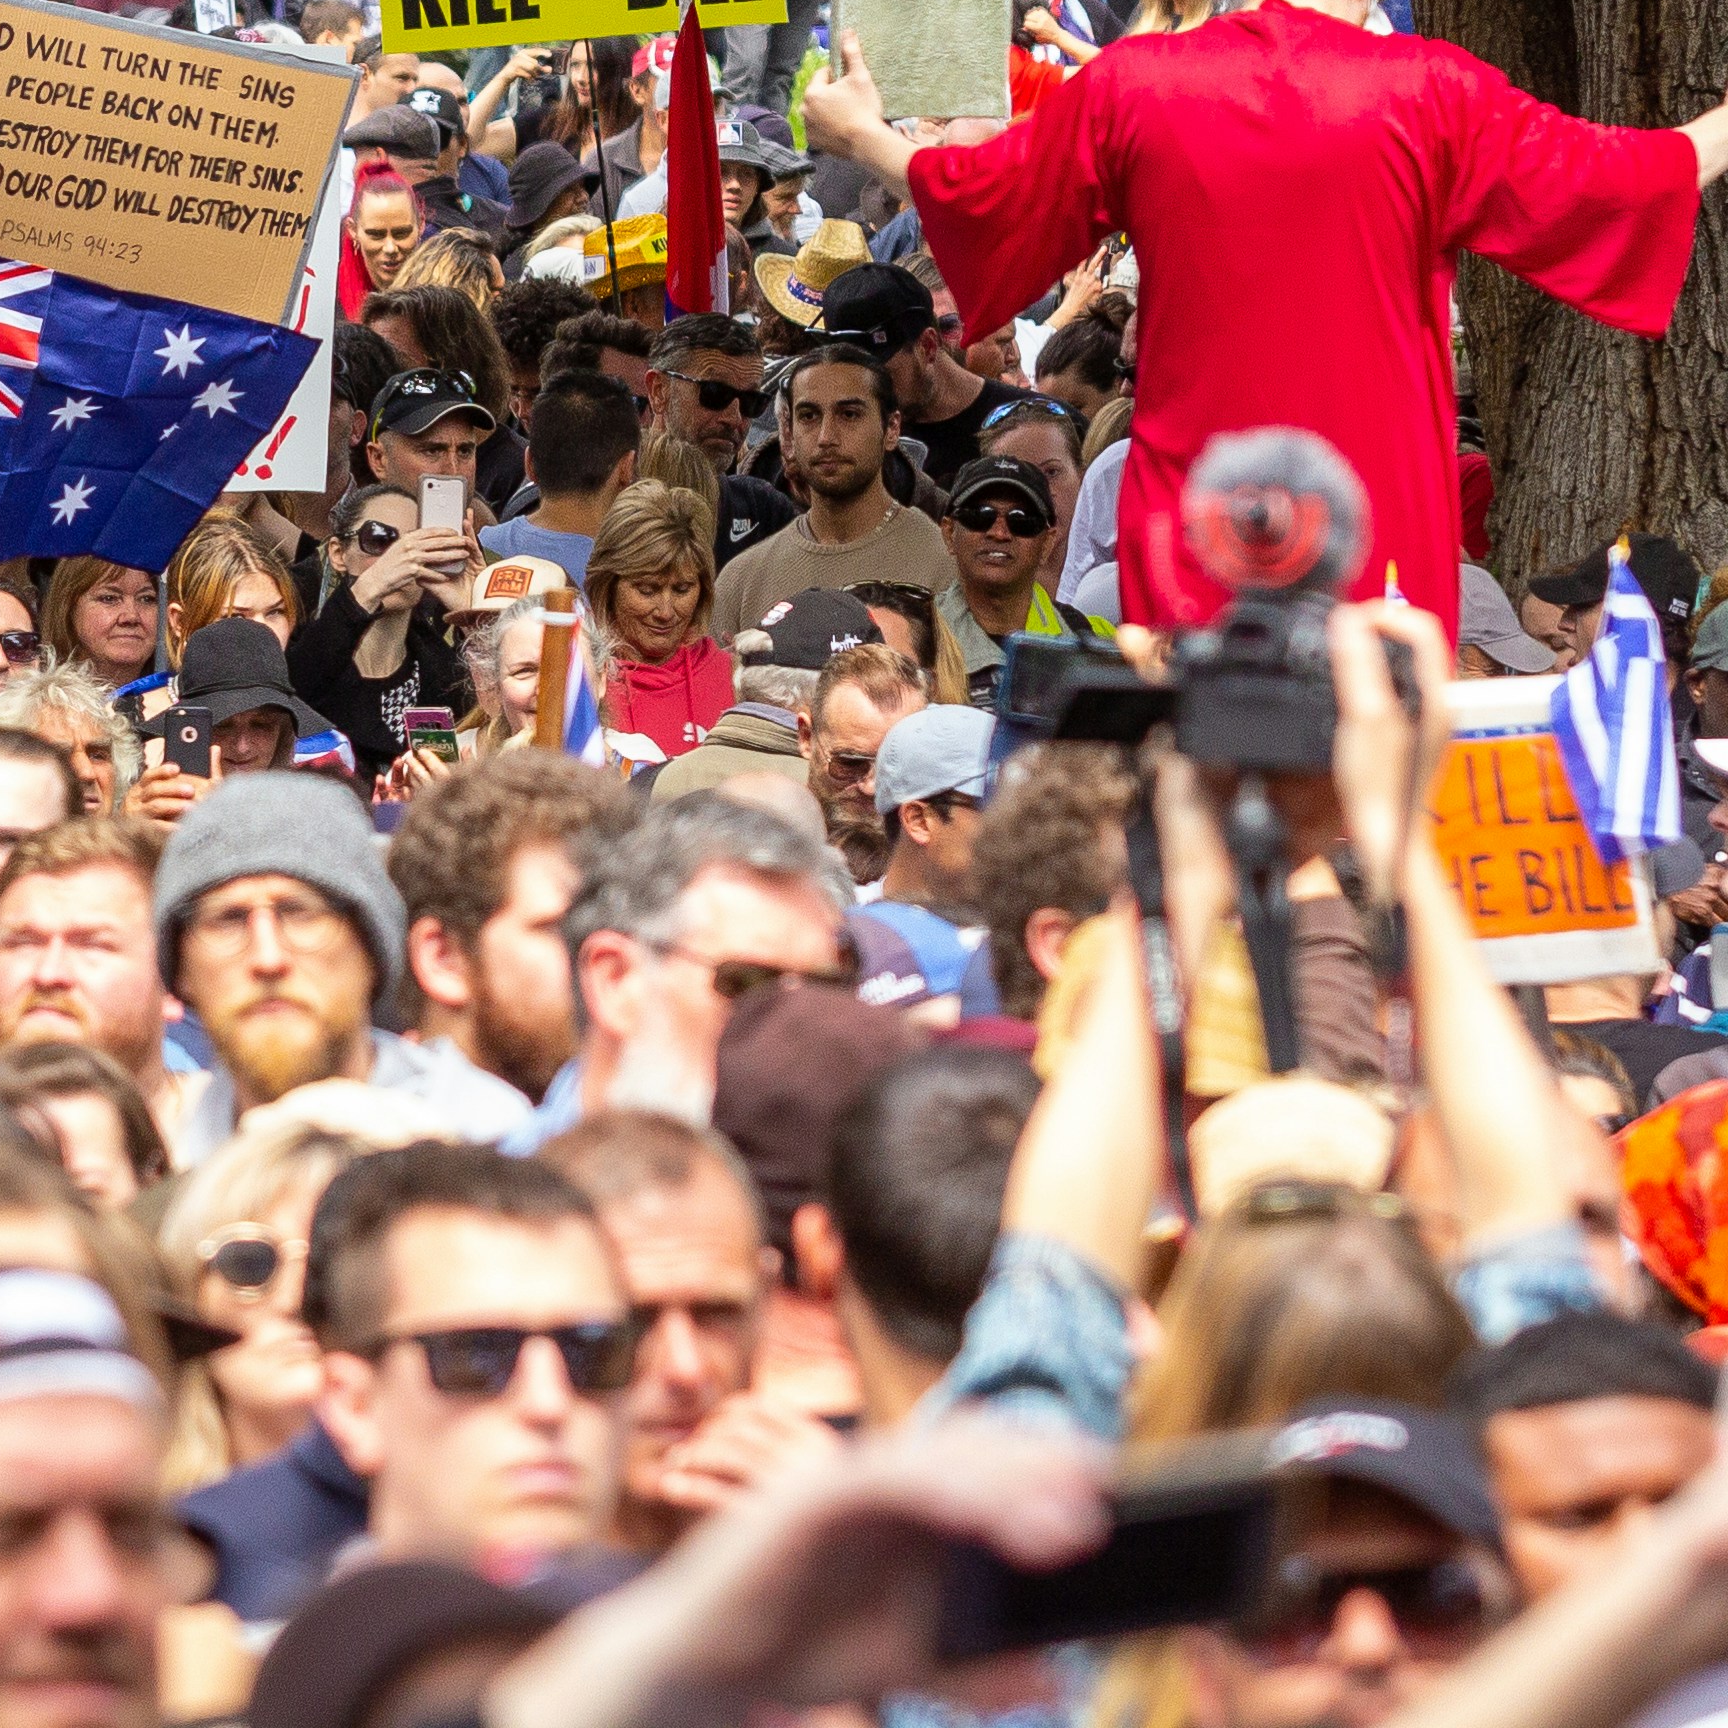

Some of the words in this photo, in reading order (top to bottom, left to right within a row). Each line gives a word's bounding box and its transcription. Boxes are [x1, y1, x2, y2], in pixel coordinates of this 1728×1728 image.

[26, 32, 88, 69] WILL
[100, 46, 172, 82] TURN
[178, 61, 223, 90] THE
[238, 74, 296, 108] SINS
[5, 74, 95, 111] PEOPLE
[101, 90, 164, 123] BACK
[168, 104, 204, 131] ON
[209, 111, 280, 148] THEM.
[82, 134, 142, 169] THEM
[142, 145, 184, 178] FOR
[189, 153, 247, 186] THEIR
[248, 164, 304, 194] SINS.
[0, 218, 74, 251] PSALMS
[84, 235, 144, 264] 94:23
[5, 169, 53, 201] OUR
[54, 174, 107, 210] GOD
[113, 187, 161, 217] WILL
[166, 194, 259, 234] DESTROY
[259, 207, 312, 240] THEM
[1429, 749, 1580, 825] ILL
[1517, 843, 1634, 917] BILL
